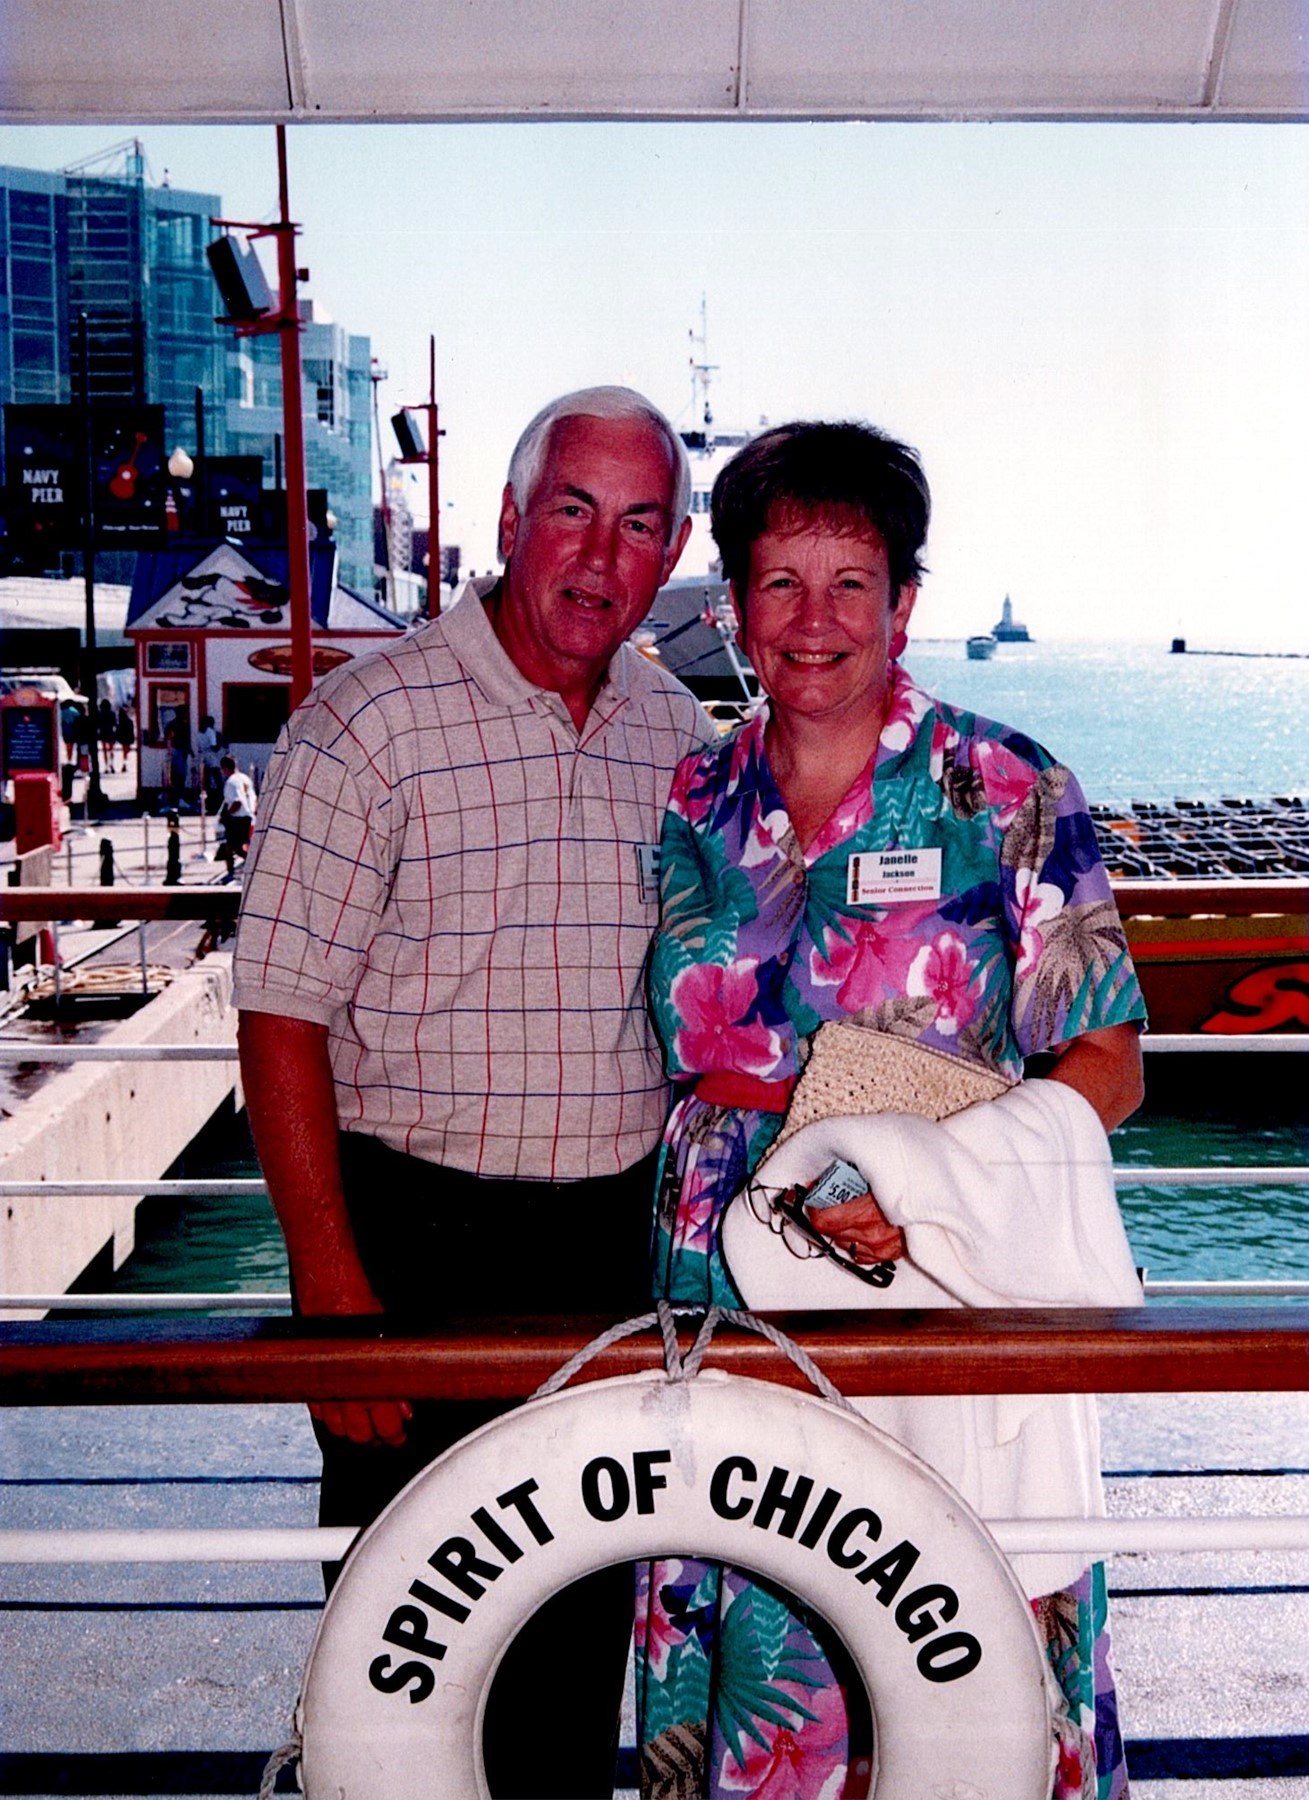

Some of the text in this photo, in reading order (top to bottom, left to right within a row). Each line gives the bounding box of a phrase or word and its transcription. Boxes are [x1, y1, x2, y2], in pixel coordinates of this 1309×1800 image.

[23, 469, 59, 484] NAVY
[32, 488, 63, 503] PIER
[220, 505, 247, 517] NAVY
[227, 519, 251, 532] PIER
[879, 854, 918, 865] Janelle
[882, 870, 915, 879] Jackson
[862, 885, 934, 895] Senior Connection
[369, 1450, 981, 1703] SPIRIT OF CHICAGO
